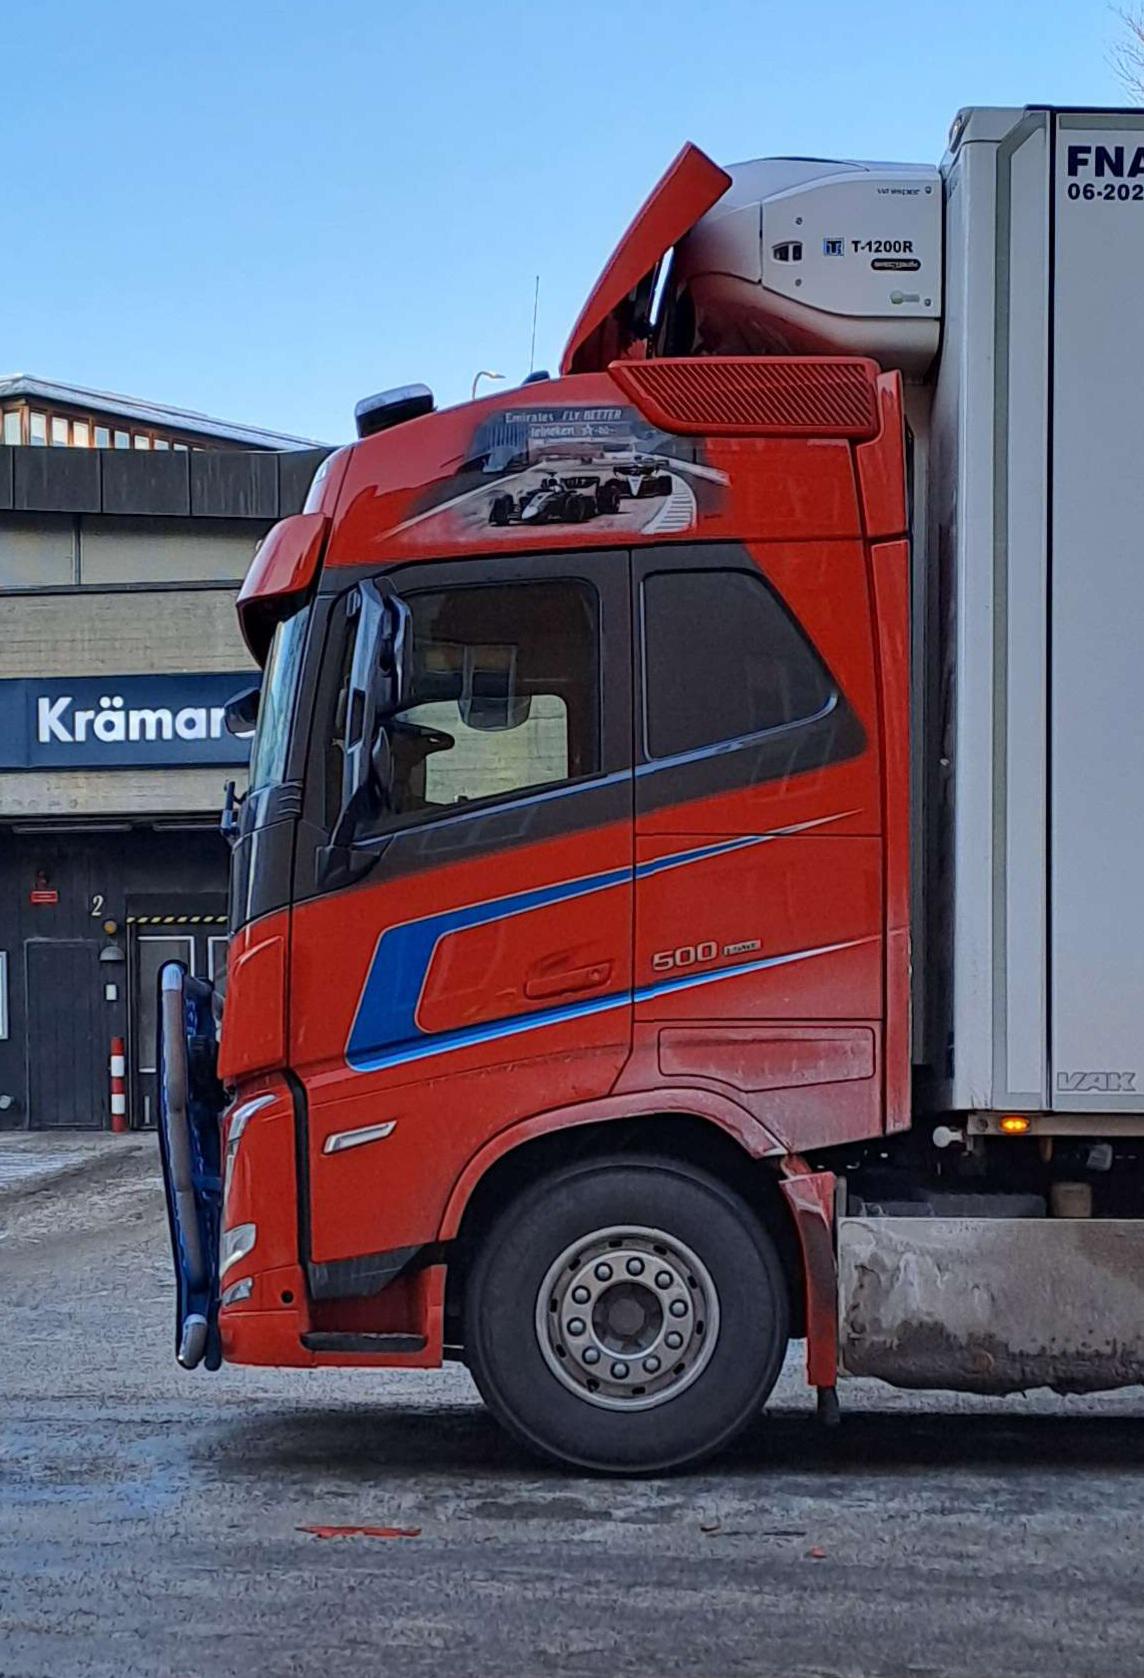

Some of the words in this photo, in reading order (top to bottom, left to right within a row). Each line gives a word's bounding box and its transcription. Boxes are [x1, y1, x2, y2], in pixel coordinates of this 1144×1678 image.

[851, 240, 913, 254] T-1200R
[505, 412, 555, 424] Emirates
[37, 695, 256, 743] Krämar
[91, 894, 104, 917] 2
[652, 940, 718, 972] 500
[1057, 1071, 1136, 1092] VAK
